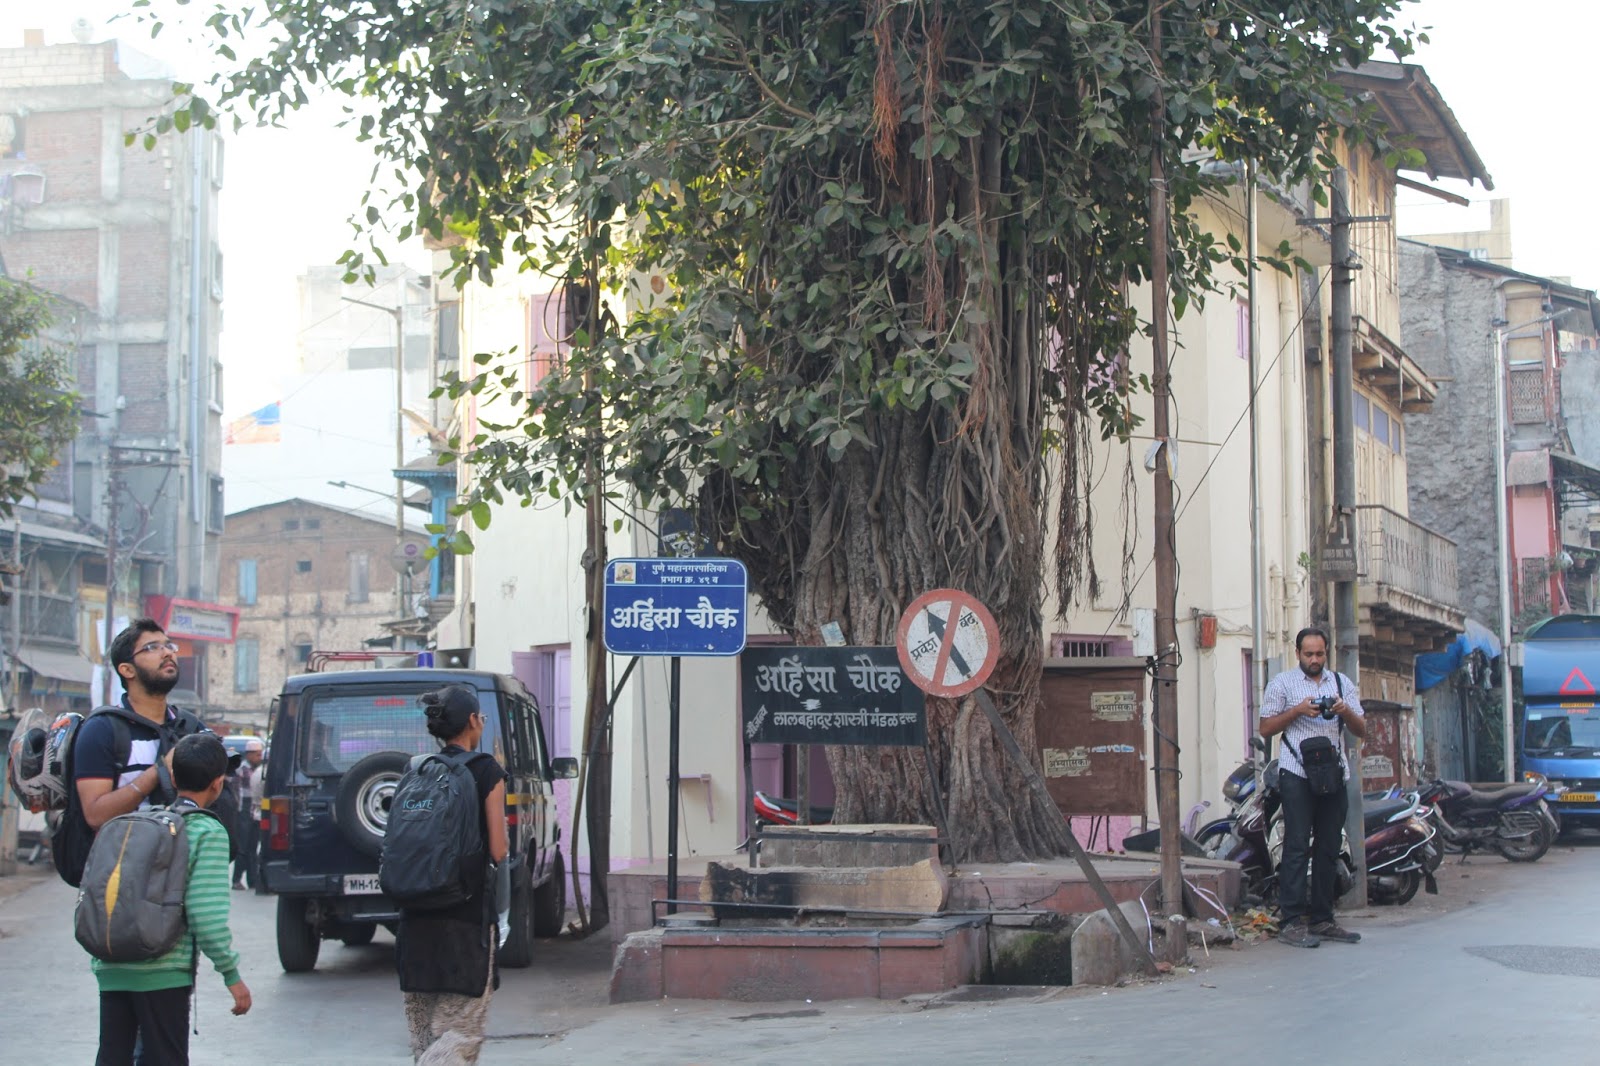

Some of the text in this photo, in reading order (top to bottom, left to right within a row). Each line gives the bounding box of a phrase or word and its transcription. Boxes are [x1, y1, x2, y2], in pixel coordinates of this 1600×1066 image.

[652, 563, 728, 575] पुणे महानगरपालिका
[661, 576, 683, 584] प्रभाग
[611, 596, 739, 632] अहिंसा चौक
[910, 612, 979, 661] प्रवेश बंद
[755, 654, 901, 698] अहिंसा चौक
[833, 708, 869, 728] शास्त्री
[870, 707, 898, 728] मंडळ
